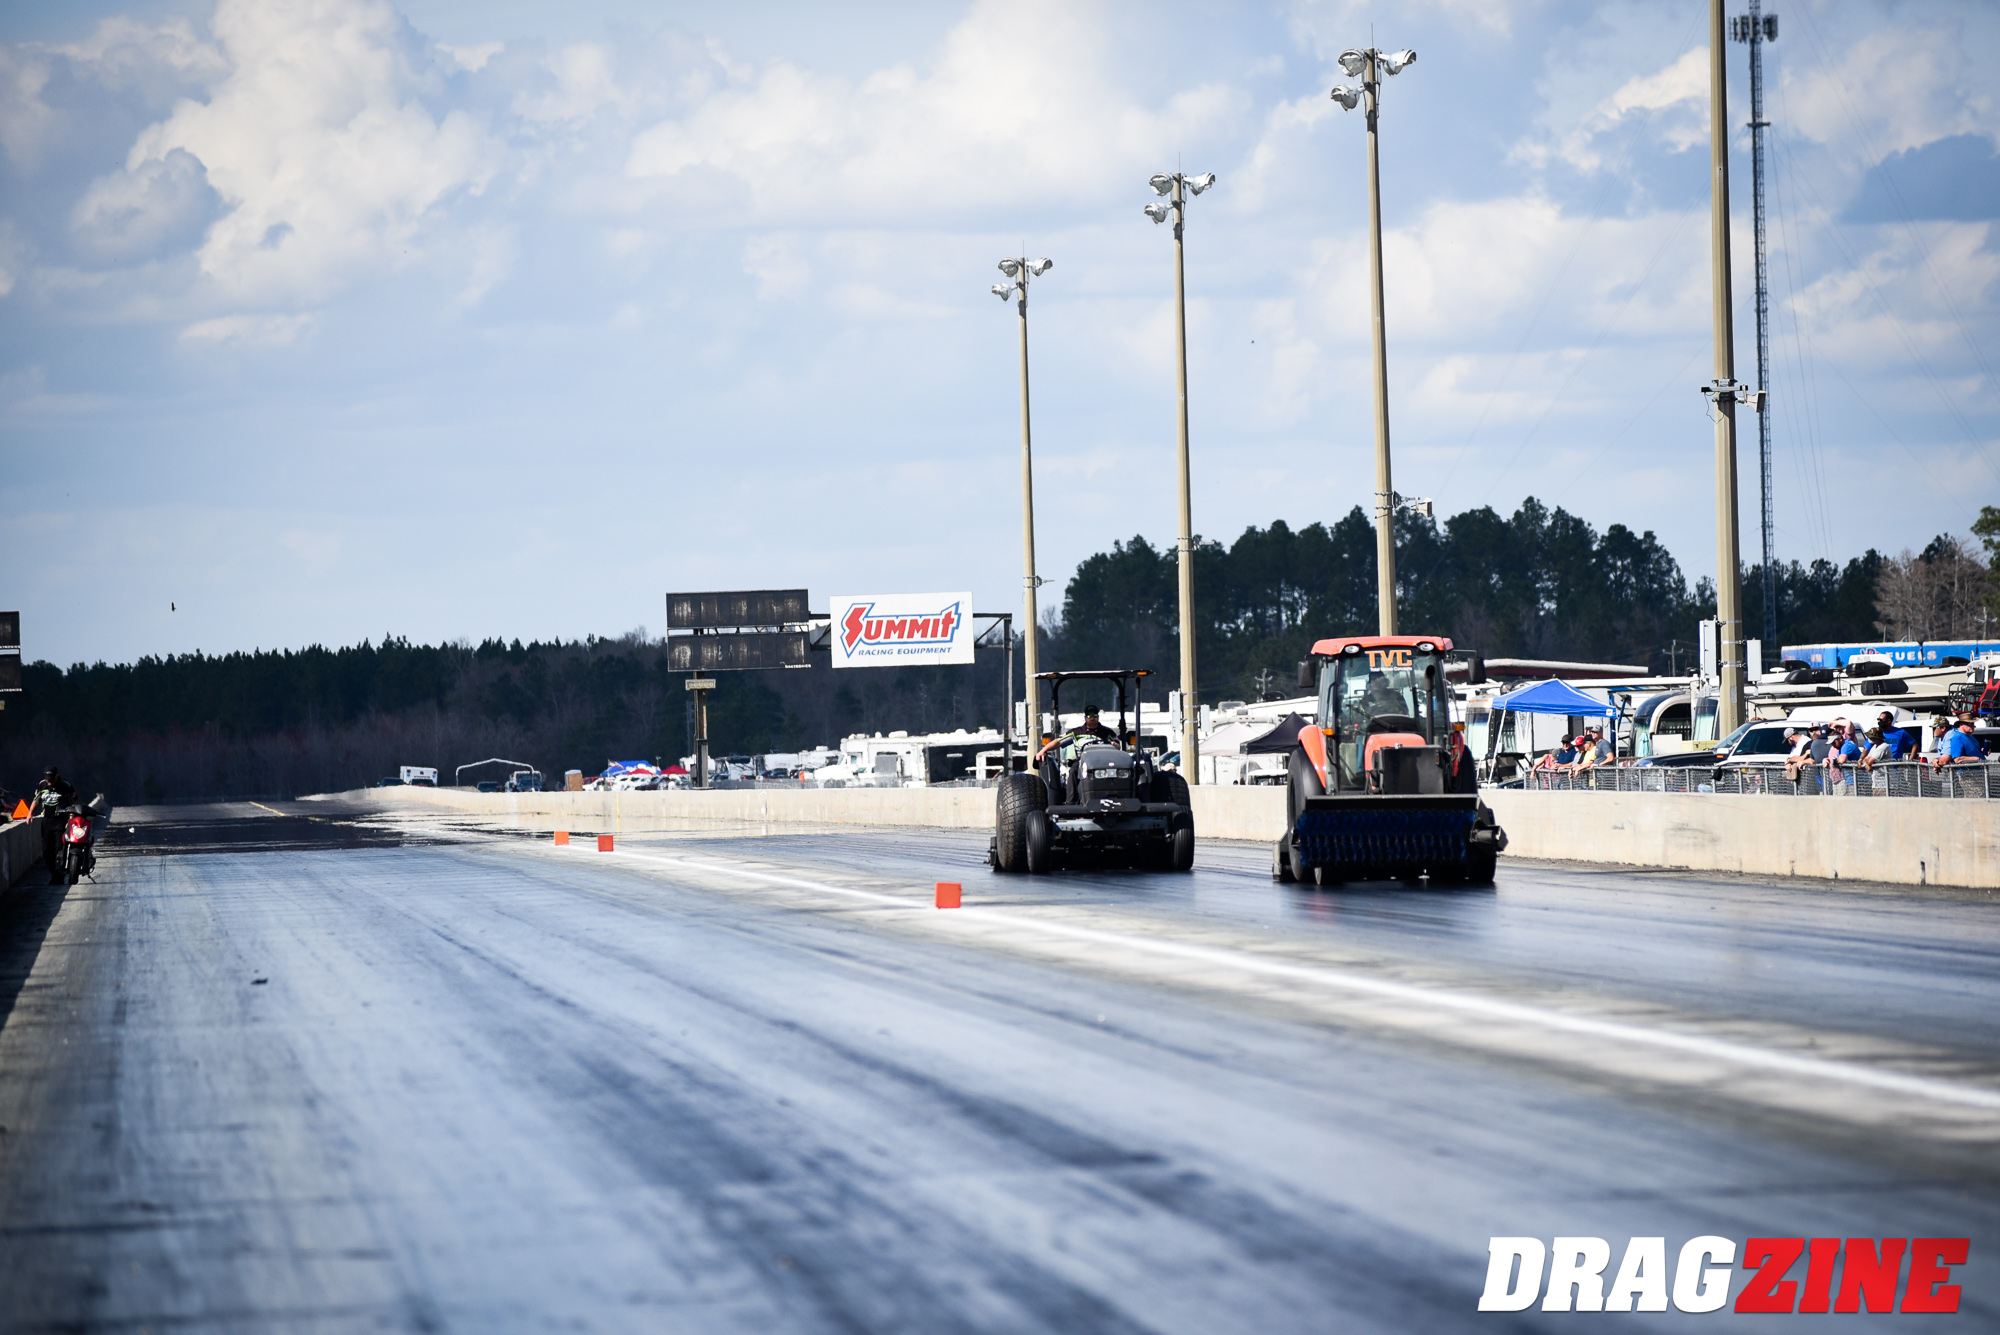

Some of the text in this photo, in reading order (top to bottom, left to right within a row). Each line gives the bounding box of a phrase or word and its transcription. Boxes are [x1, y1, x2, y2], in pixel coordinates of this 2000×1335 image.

[858, 646, 953, 656] RACING EQUIPMENT
[1364, 649, 1413, 667] TVC
